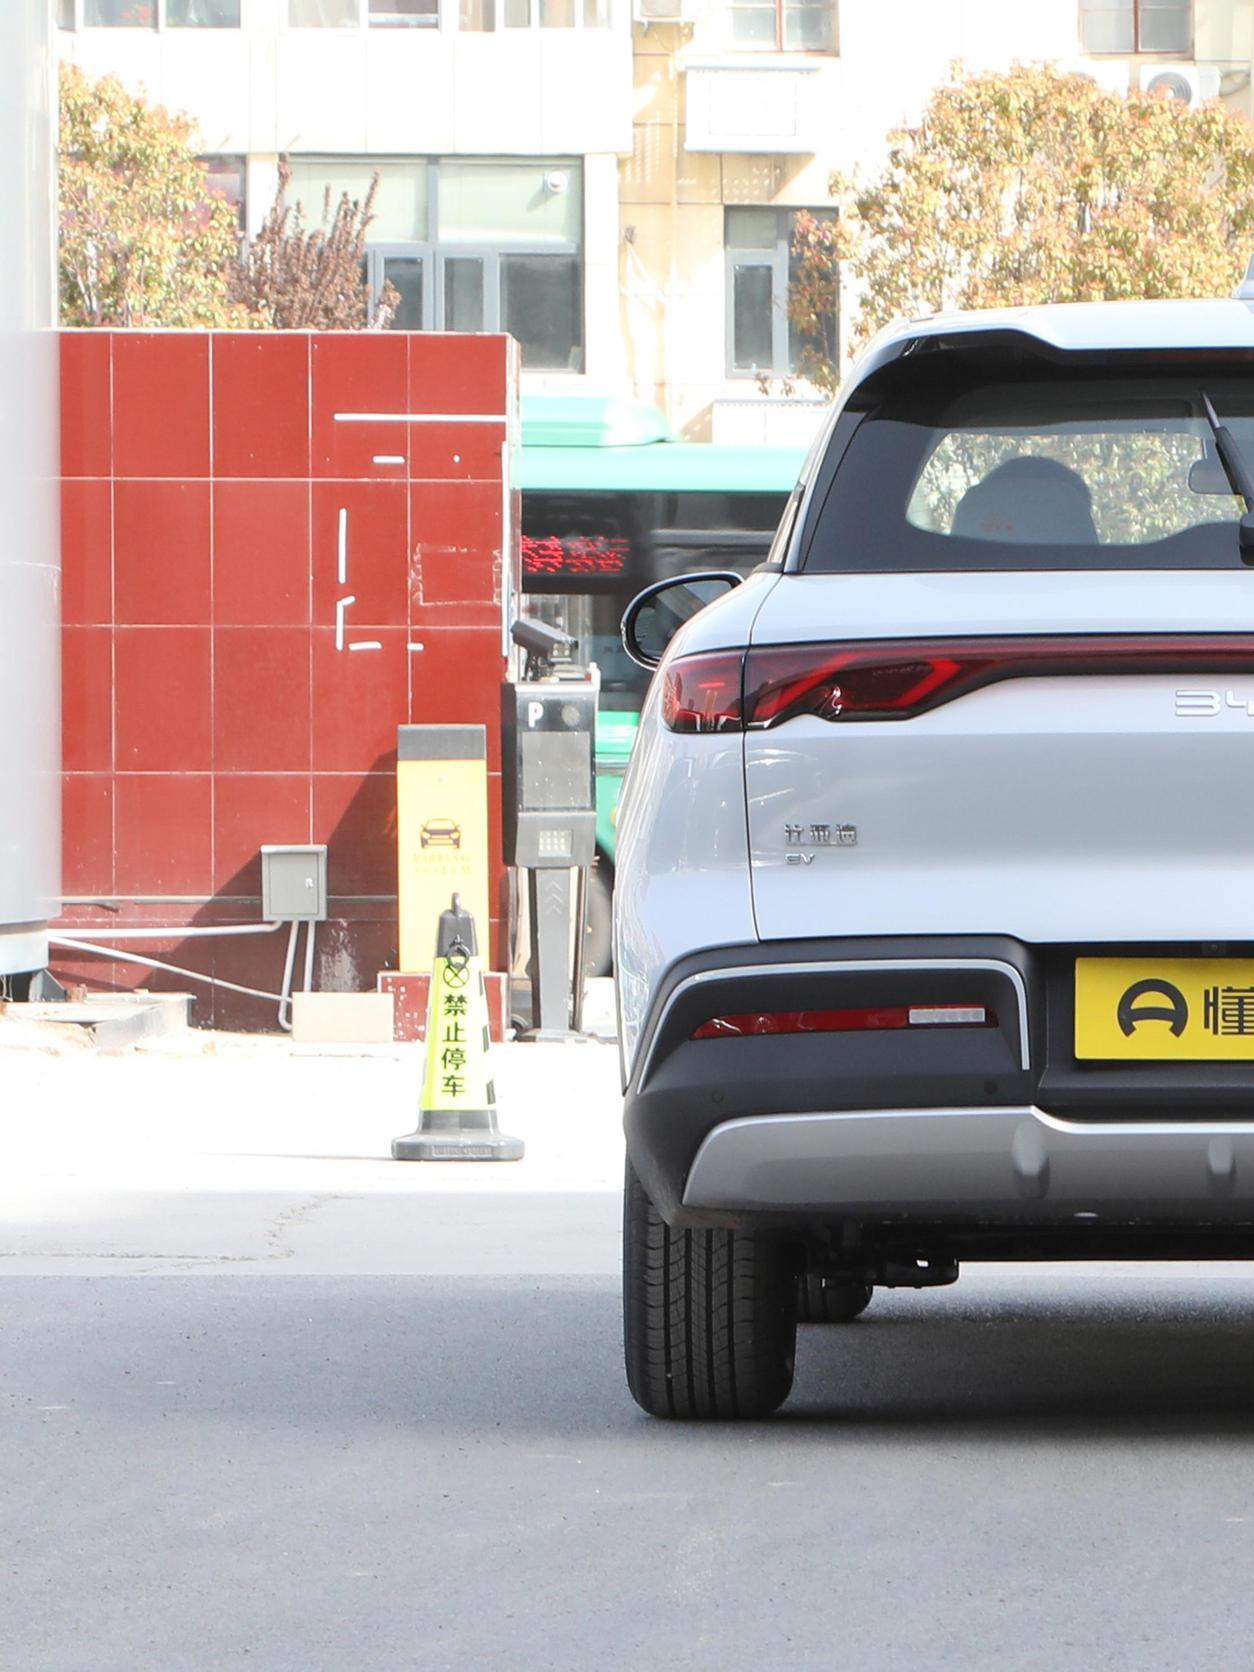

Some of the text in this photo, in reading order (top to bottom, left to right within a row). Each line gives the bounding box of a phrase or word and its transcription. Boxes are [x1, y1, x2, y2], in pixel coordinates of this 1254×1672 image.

[528, 701, 544, 728] P
[784, 823, 858, 847] 比亚迪
[785, 853, 815, 866] EV
[441, 993, 468, 1098] 禁止停车
